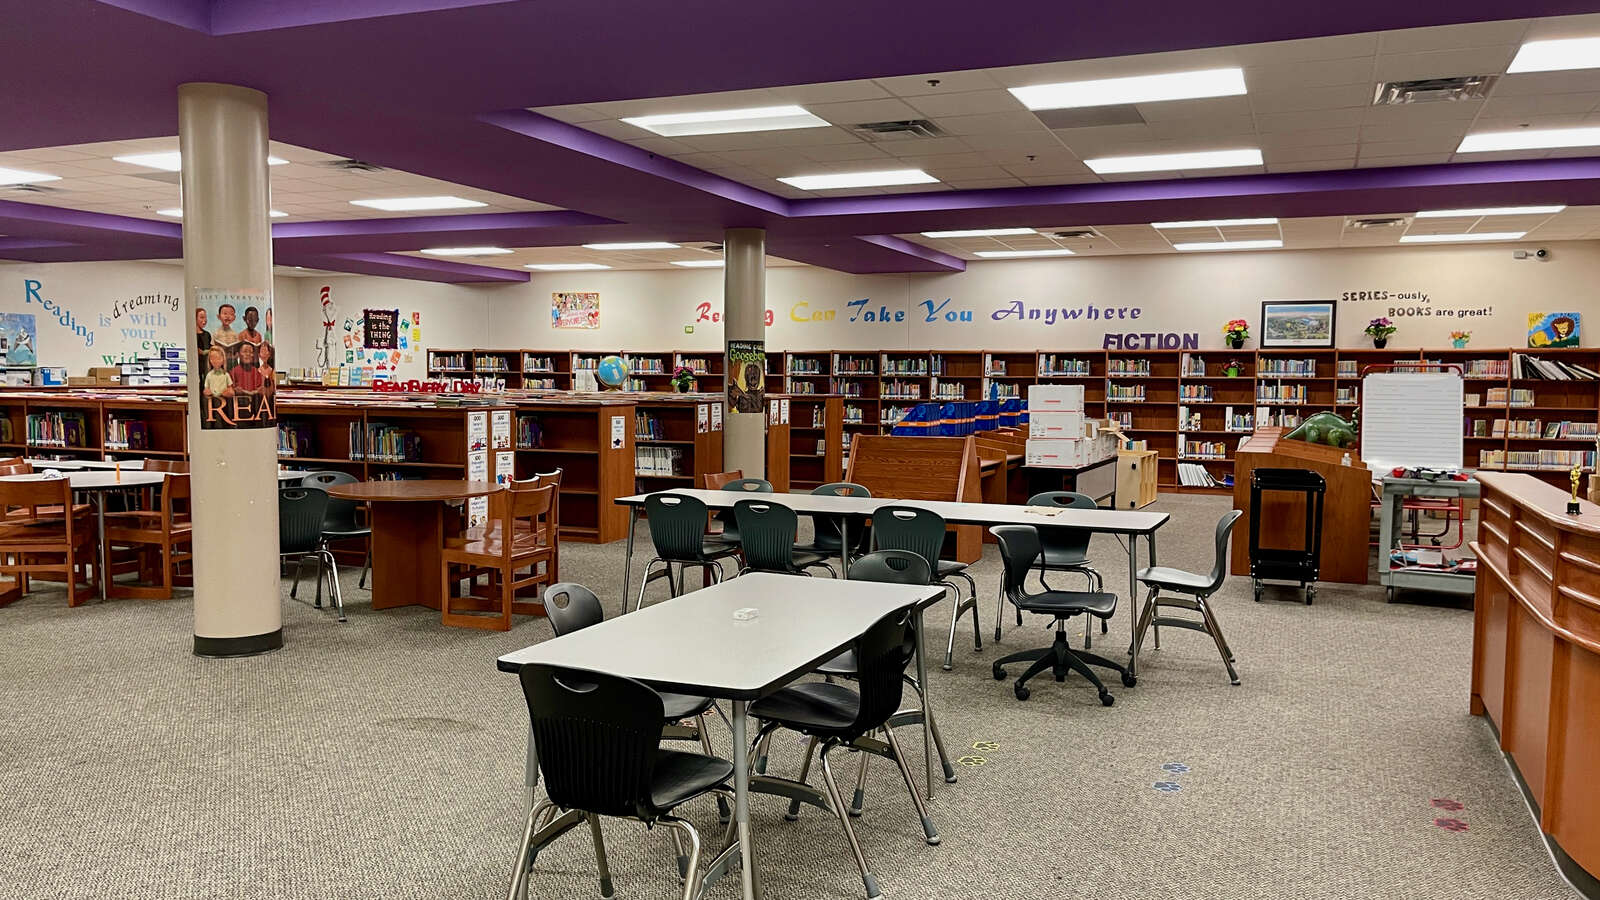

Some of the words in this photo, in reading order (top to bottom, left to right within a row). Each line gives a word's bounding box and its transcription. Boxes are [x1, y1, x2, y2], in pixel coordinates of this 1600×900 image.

[24, 279, 94, 347] Reading
[99, 312, 111, 328] is
[113, 291, 179, 319] dreaming
[790, 301, 836, 322] Can
[847, 299, 905, 322] Take
[918, 298, 973, 322] You
[991, 300, 1142, 325] Anywhere
[1388, 306, 1432, 317] BOOKS
[1435, 309, 1454, 317] are
[1457, 306, 1493, 318] great!
[129, 312, 167, 328] with
[120, 327, 156, 343] your
[369, 331, 392, 339] THING
[1103, 333, 1199, 349] FICTION
[102, 351, 139, 366] wid
